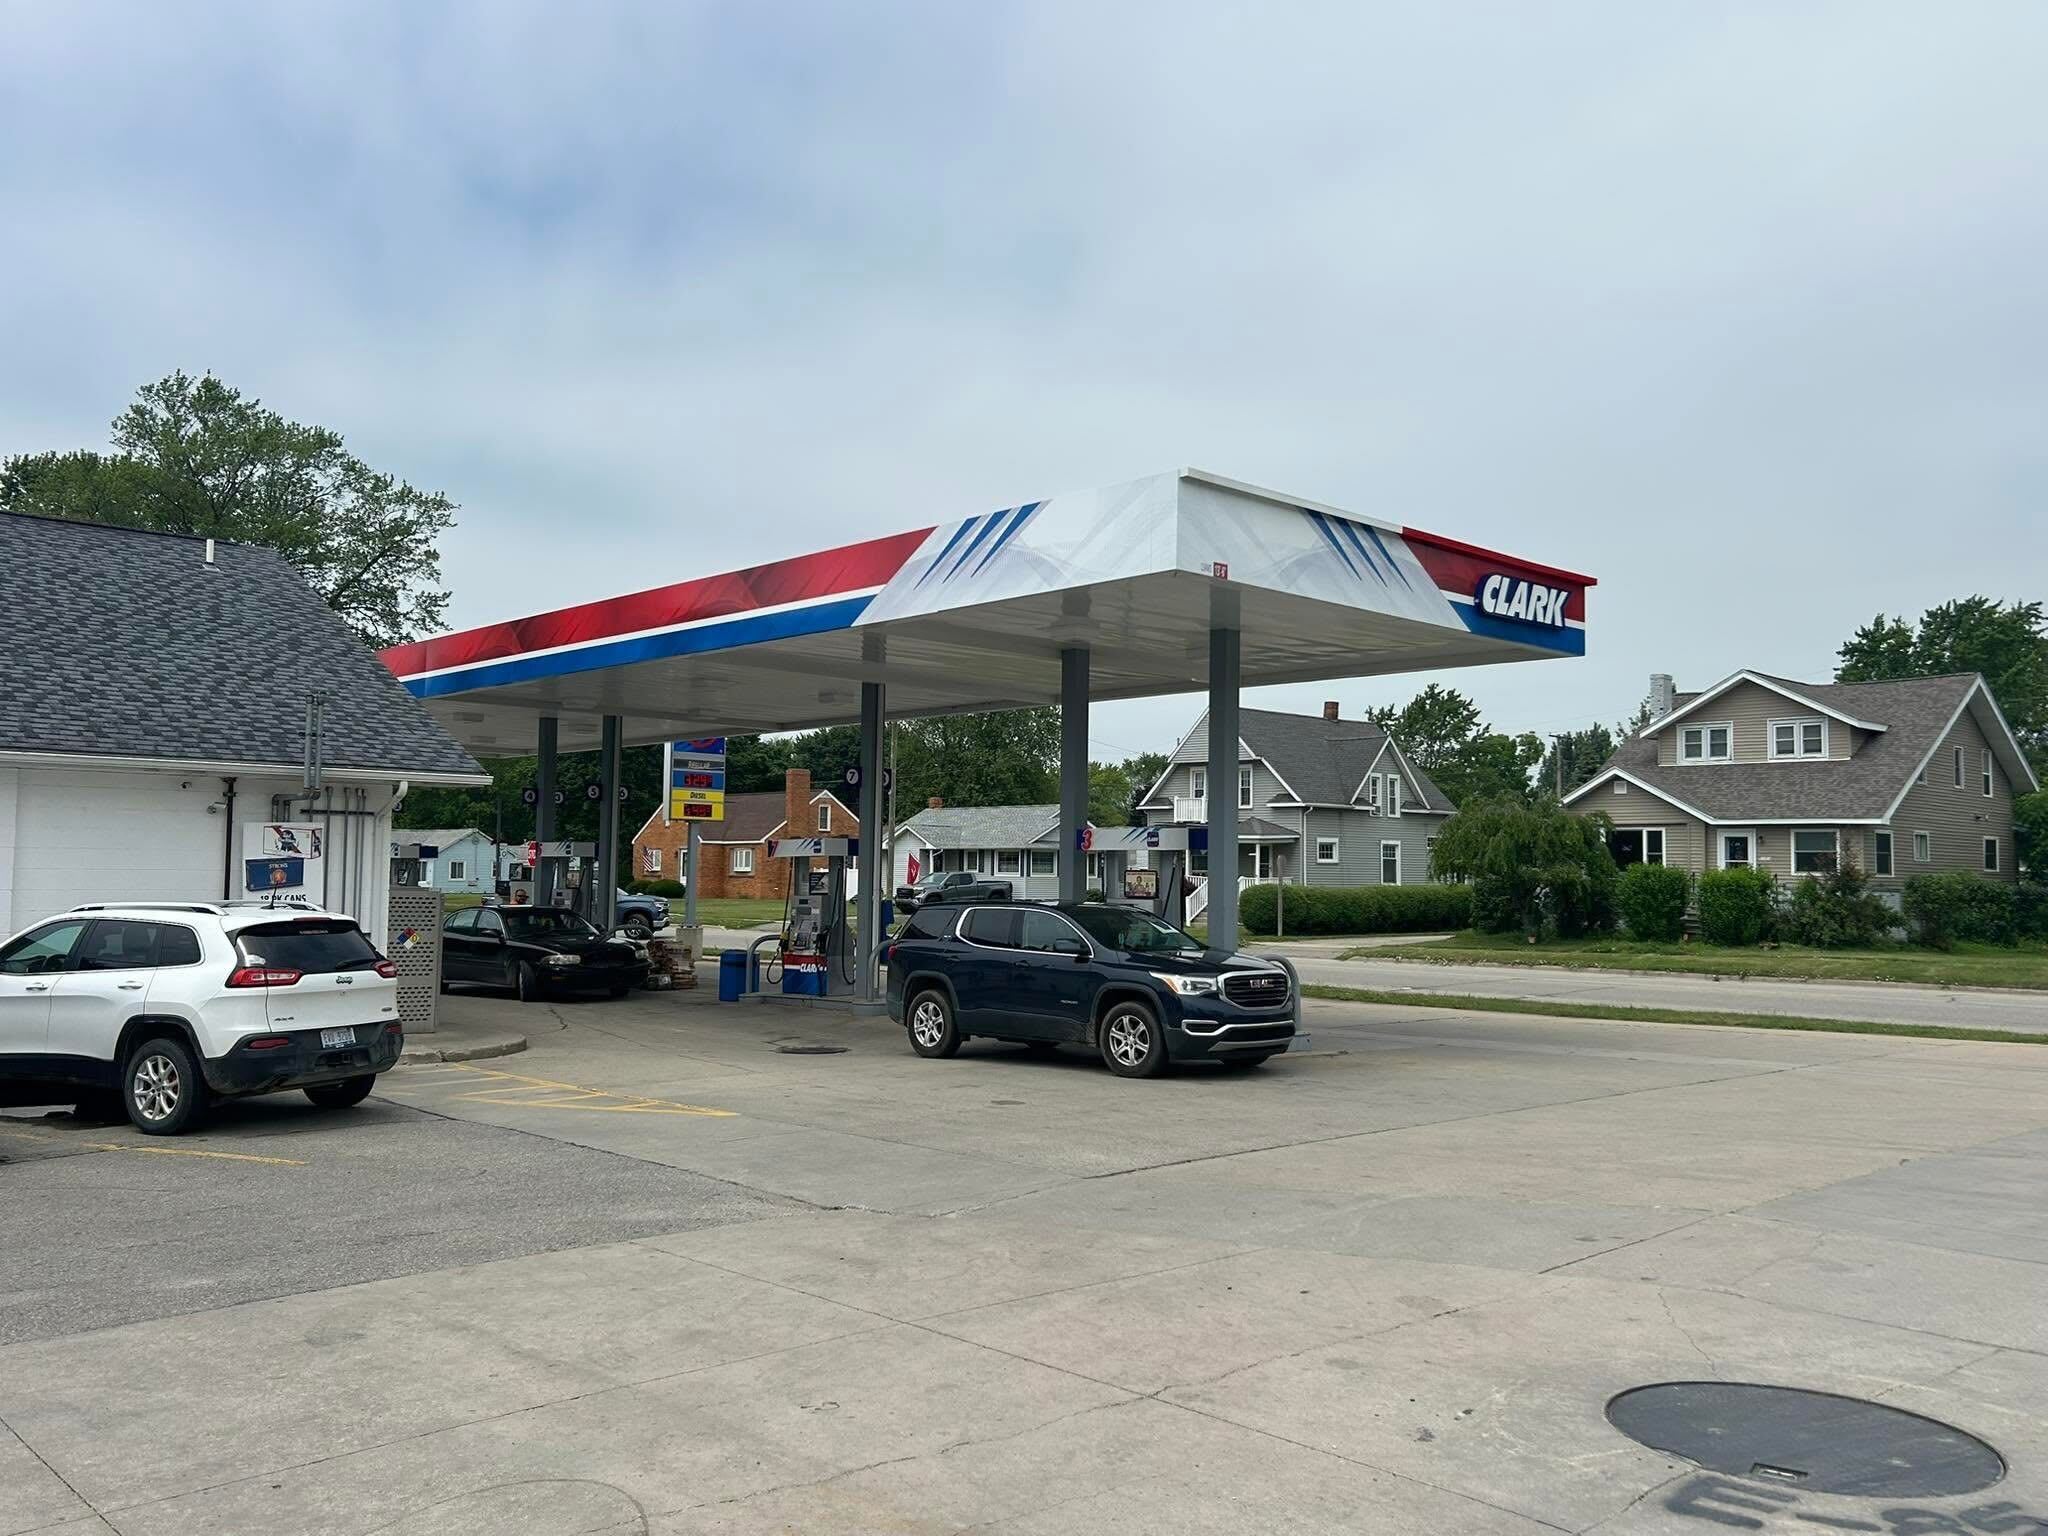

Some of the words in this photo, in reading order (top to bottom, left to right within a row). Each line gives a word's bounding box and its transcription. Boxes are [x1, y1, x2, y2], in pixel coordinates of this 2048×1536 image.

[1482, 574, 1569, 627] CLARK
[690, 791, 706, 800] DIESEL
[1081, 828, 1094, 852] 3
